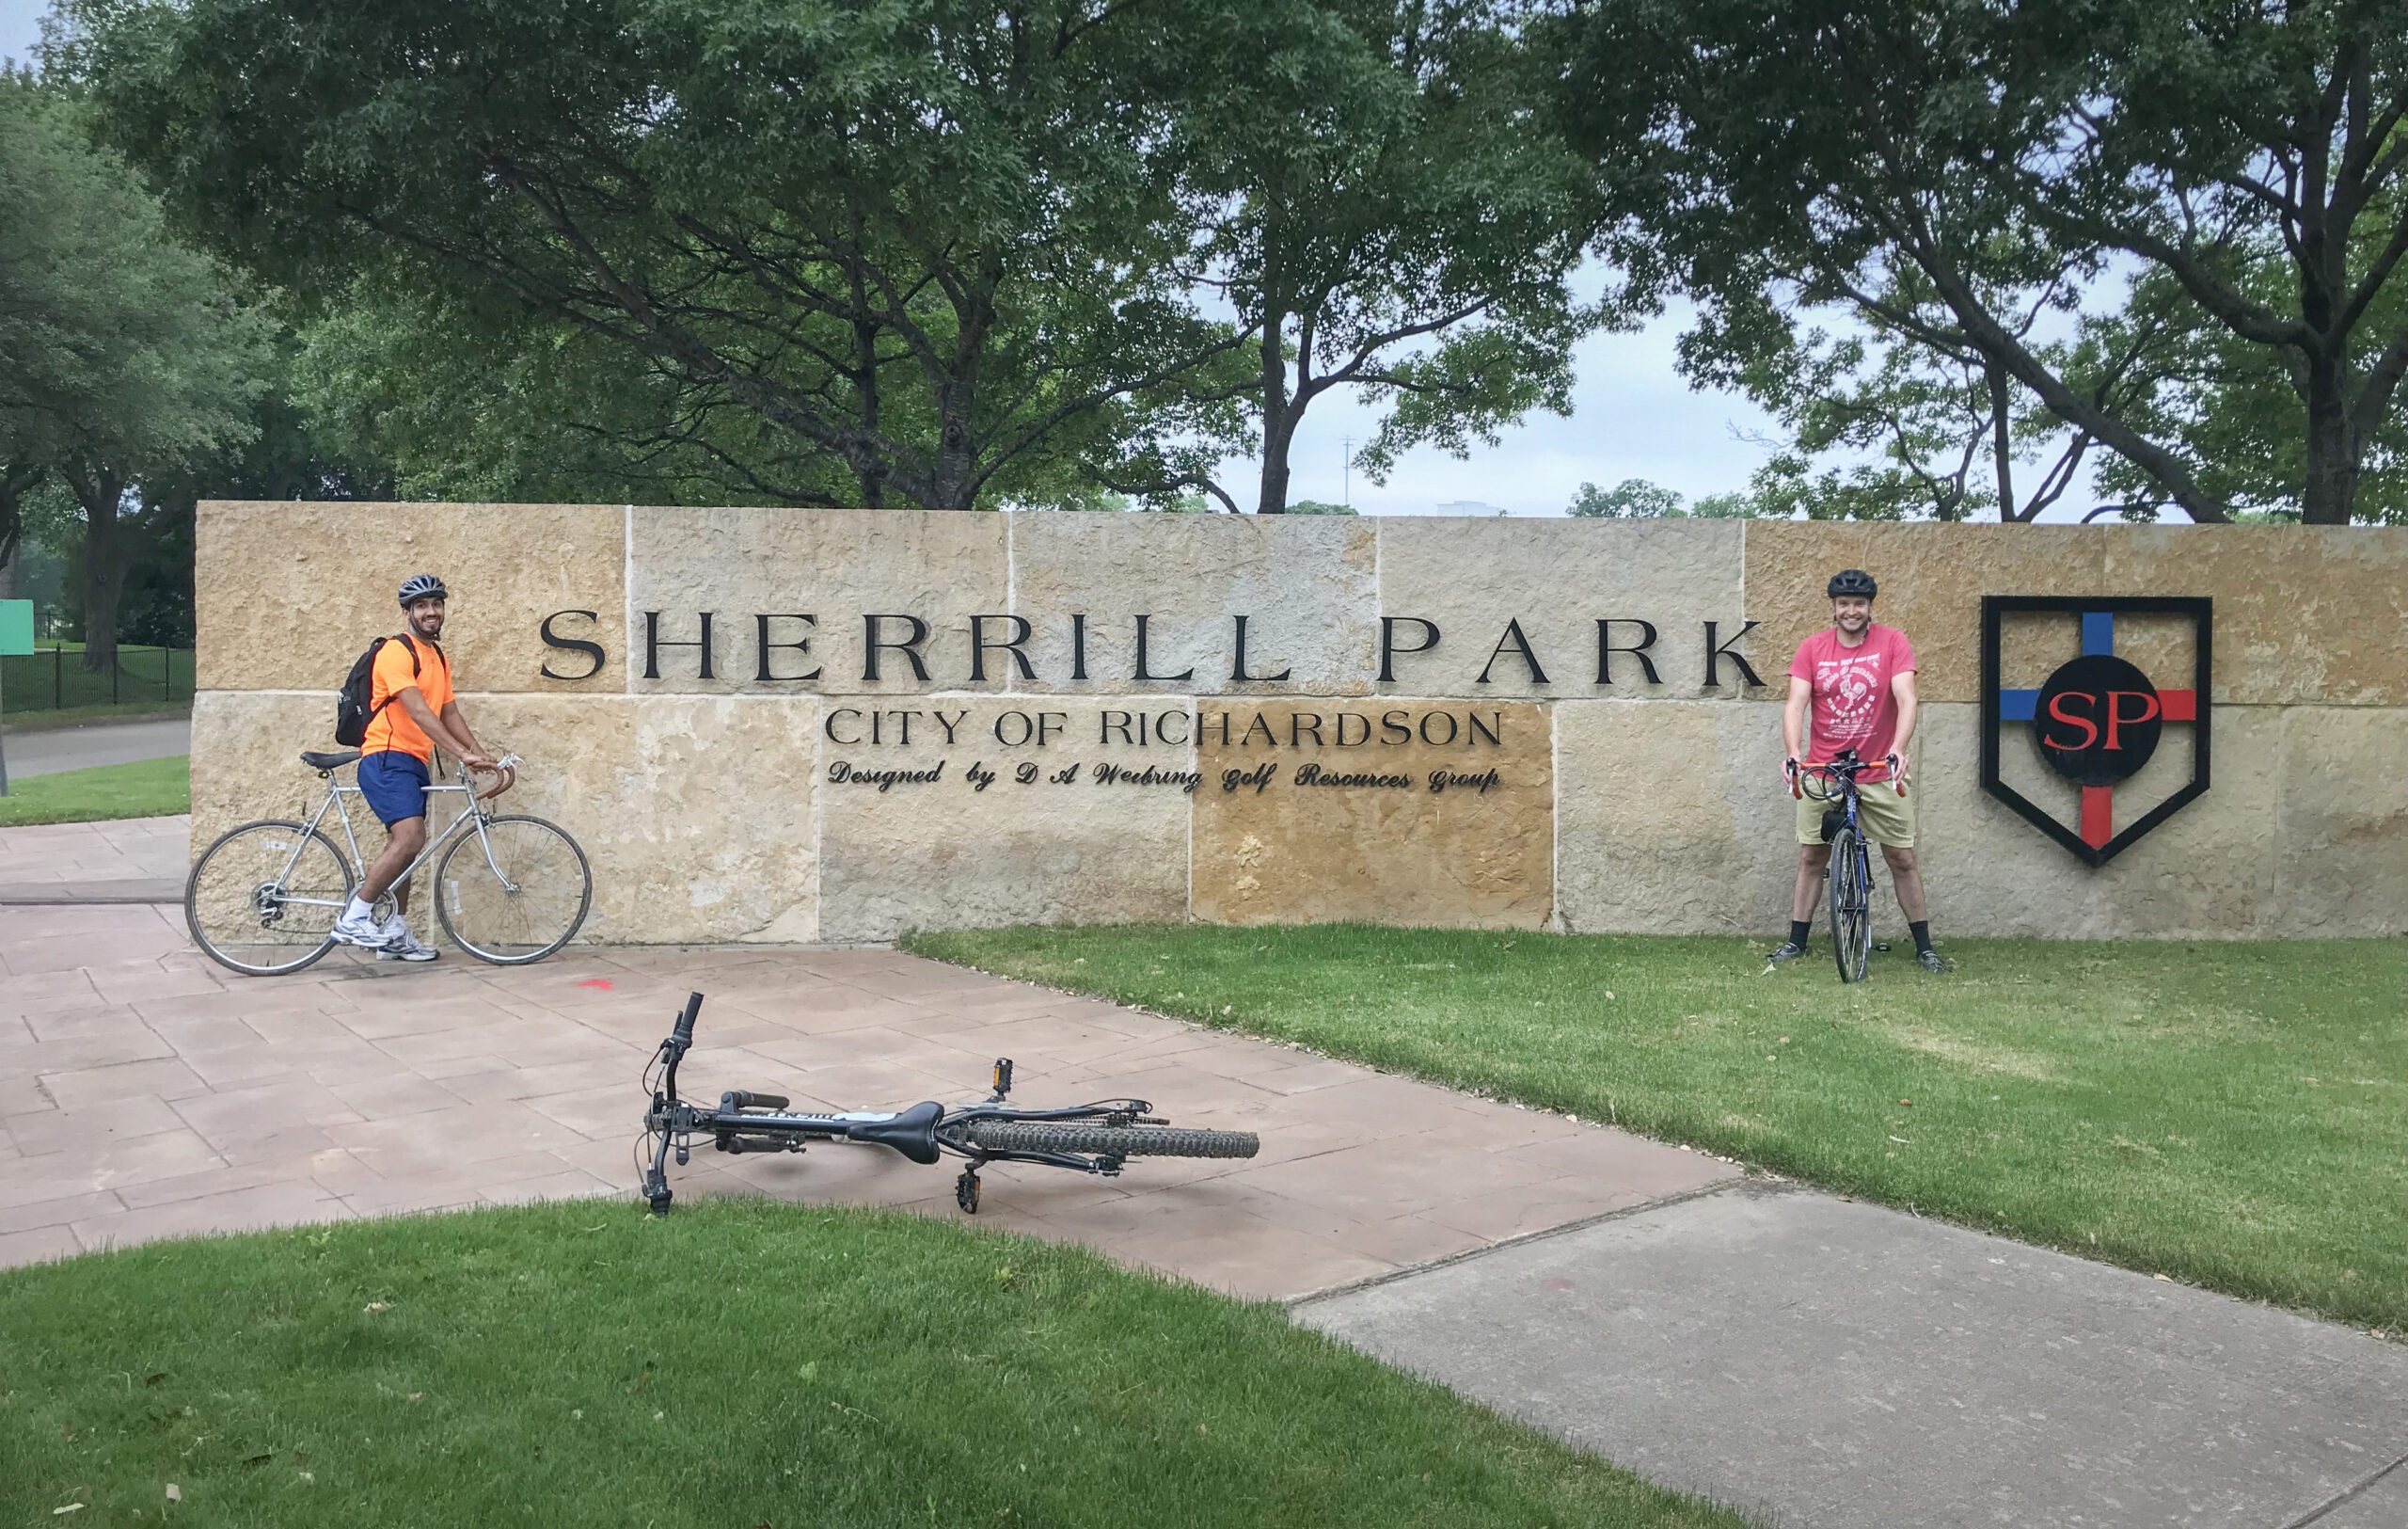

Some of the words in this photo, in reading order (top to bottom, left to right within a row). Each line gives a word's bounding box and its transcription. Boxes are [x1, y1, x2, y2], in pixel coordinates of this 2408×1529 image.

[540, 610, 1292, 681] SHERRILL
[1377, 616, 1768, 687] PARK
[825, 709, 968, 744] CITY
[994, 710, 1069, 746] OF
[1100, 710, 1502, 746] RICHARDSON
[2043, 692, 2160, 751] SP
[828, 759, 946, 792] Designed
[966, 761, 996, 792] by
[1015, 761, 1039, 785] D
[1050, 762, 1081, 785] A
[1093, 762, 1203, 793] Weibring
[1222, 763, 1278, 793] Golf
[1294, 763, 1413, 788] Resources
[1429, 768, 1501, 793] Group
